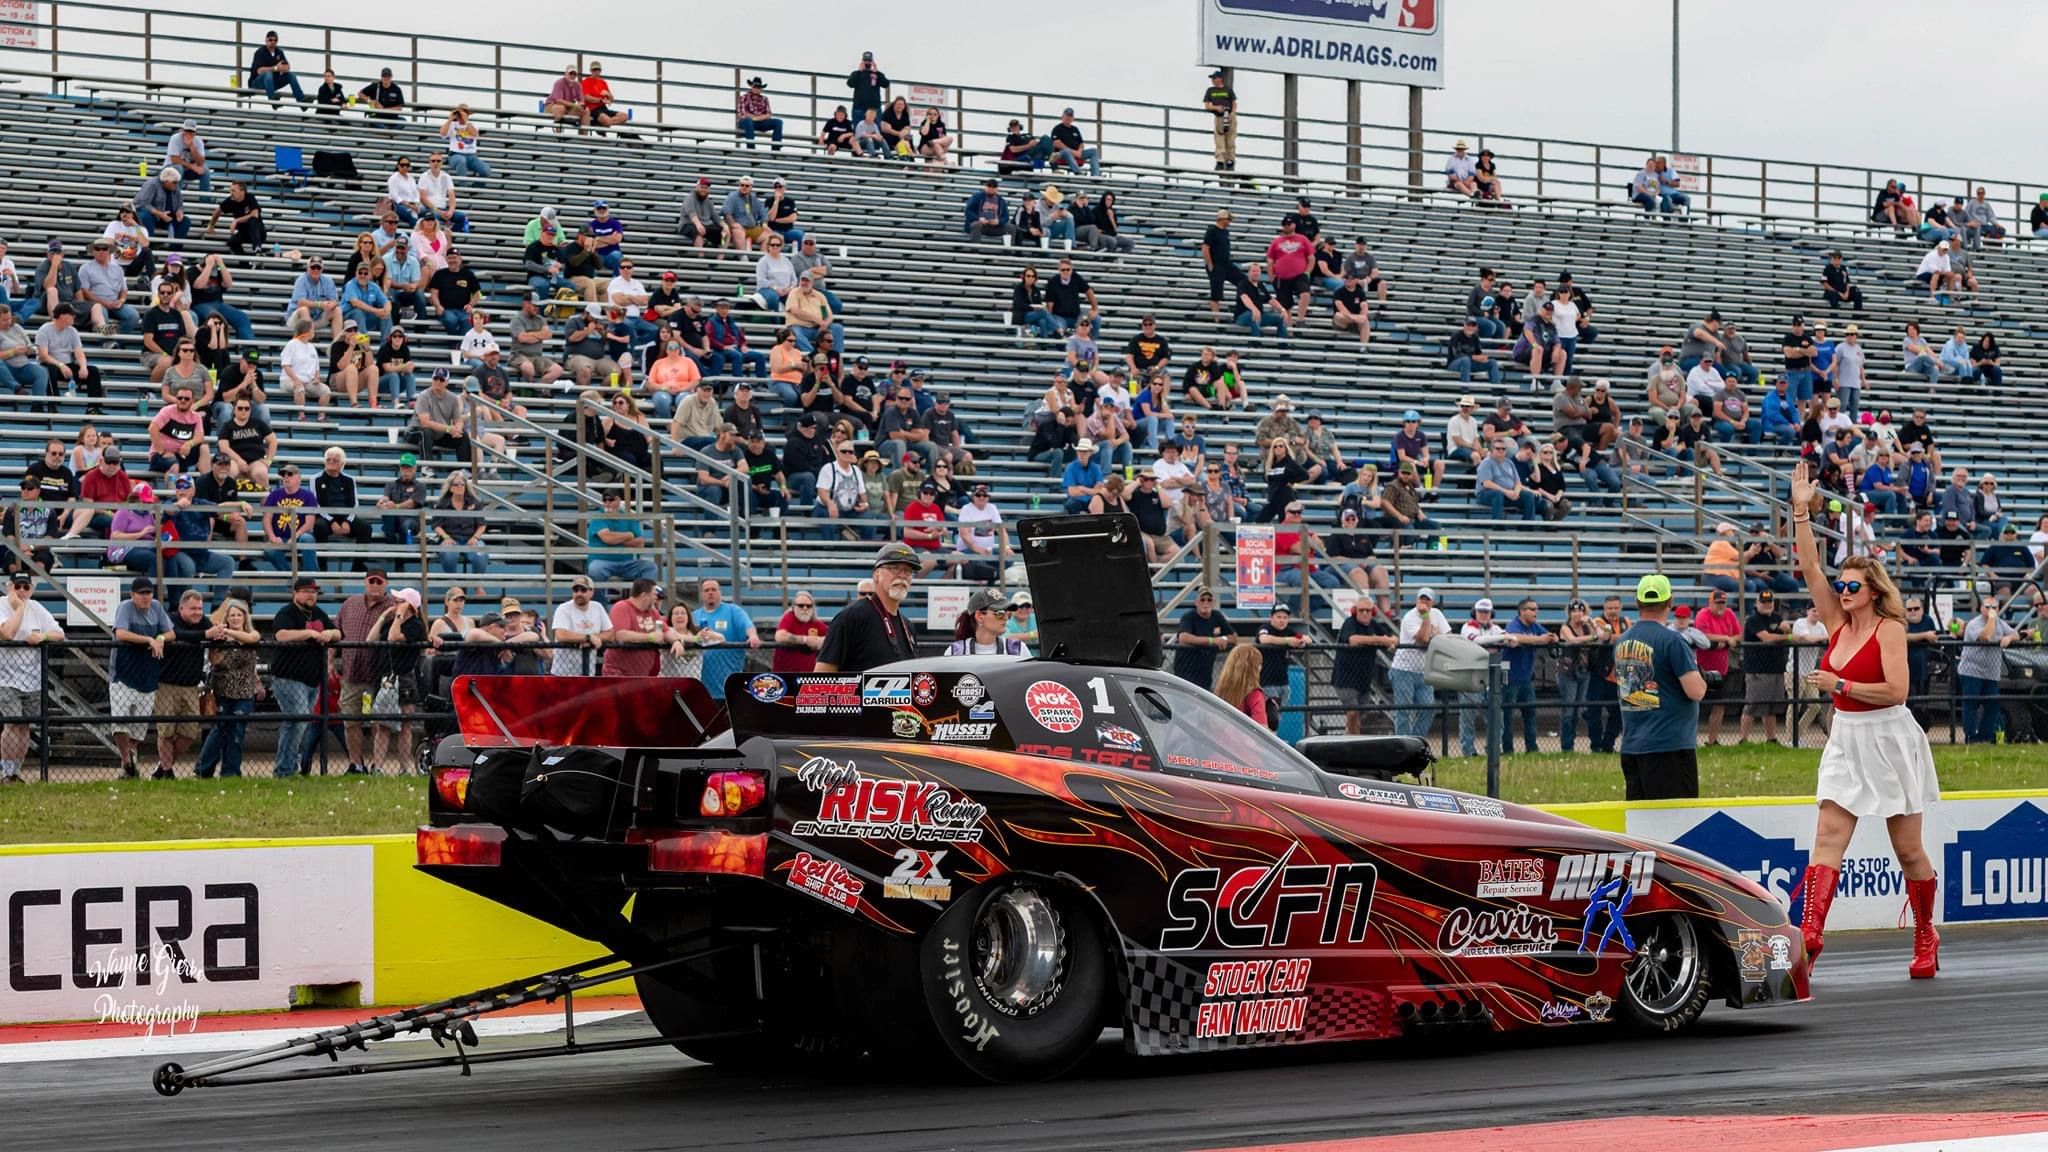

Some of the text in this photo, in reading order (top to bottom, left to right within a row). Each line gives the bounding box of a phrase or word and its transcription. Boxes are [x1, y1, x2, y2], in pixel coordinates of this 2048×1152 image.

[1215, 34, 1438, 73] www.ADRLDRAGS.com
[863, 696, 911, 706] CARRILLO
[1034, 691, 1071, 706] NGK
[1087, 677, 1115, 714] 1
[1039, 708, 1074, 717] SPARK
[1041, 715, 1077, 725] PLUGS
[931, 723, 997, 740] HUSSEY
[798, 756, 861, 797] High
[1201, 759, 1279, 781] SINGLETON
[818, 778, 939, 826] RISK
[923, 789, 987, 829] Racing
[792, 821, 900, 840] SINGLETON
[900, 826, 916, 841] &
[890, 848, 949, 880] 2X
[1479, 858, 1545, 883] BATES
[1550, 851, 1657, 900] AUTO
[1858, 857, 1890, 874] STOP
[1962, 850, 2048, 907] LOW
[804, 877, 825, 893] SHIRT
[827, 887, 847, 903] CLUB
[1482, 883, 1538, 895] Repair Service
[1437, 904, 1558, 956] Cavin
[1462, 942, 1552, 956] WRECKER SERVICE
[1204, 959, 1311, 997] STOCK CAR
[974, 975, 1019, 1016] RACING
[1028, 983, 1063, 1016] WELD
[1196, 998, 1308, 1038] FAN NATION
